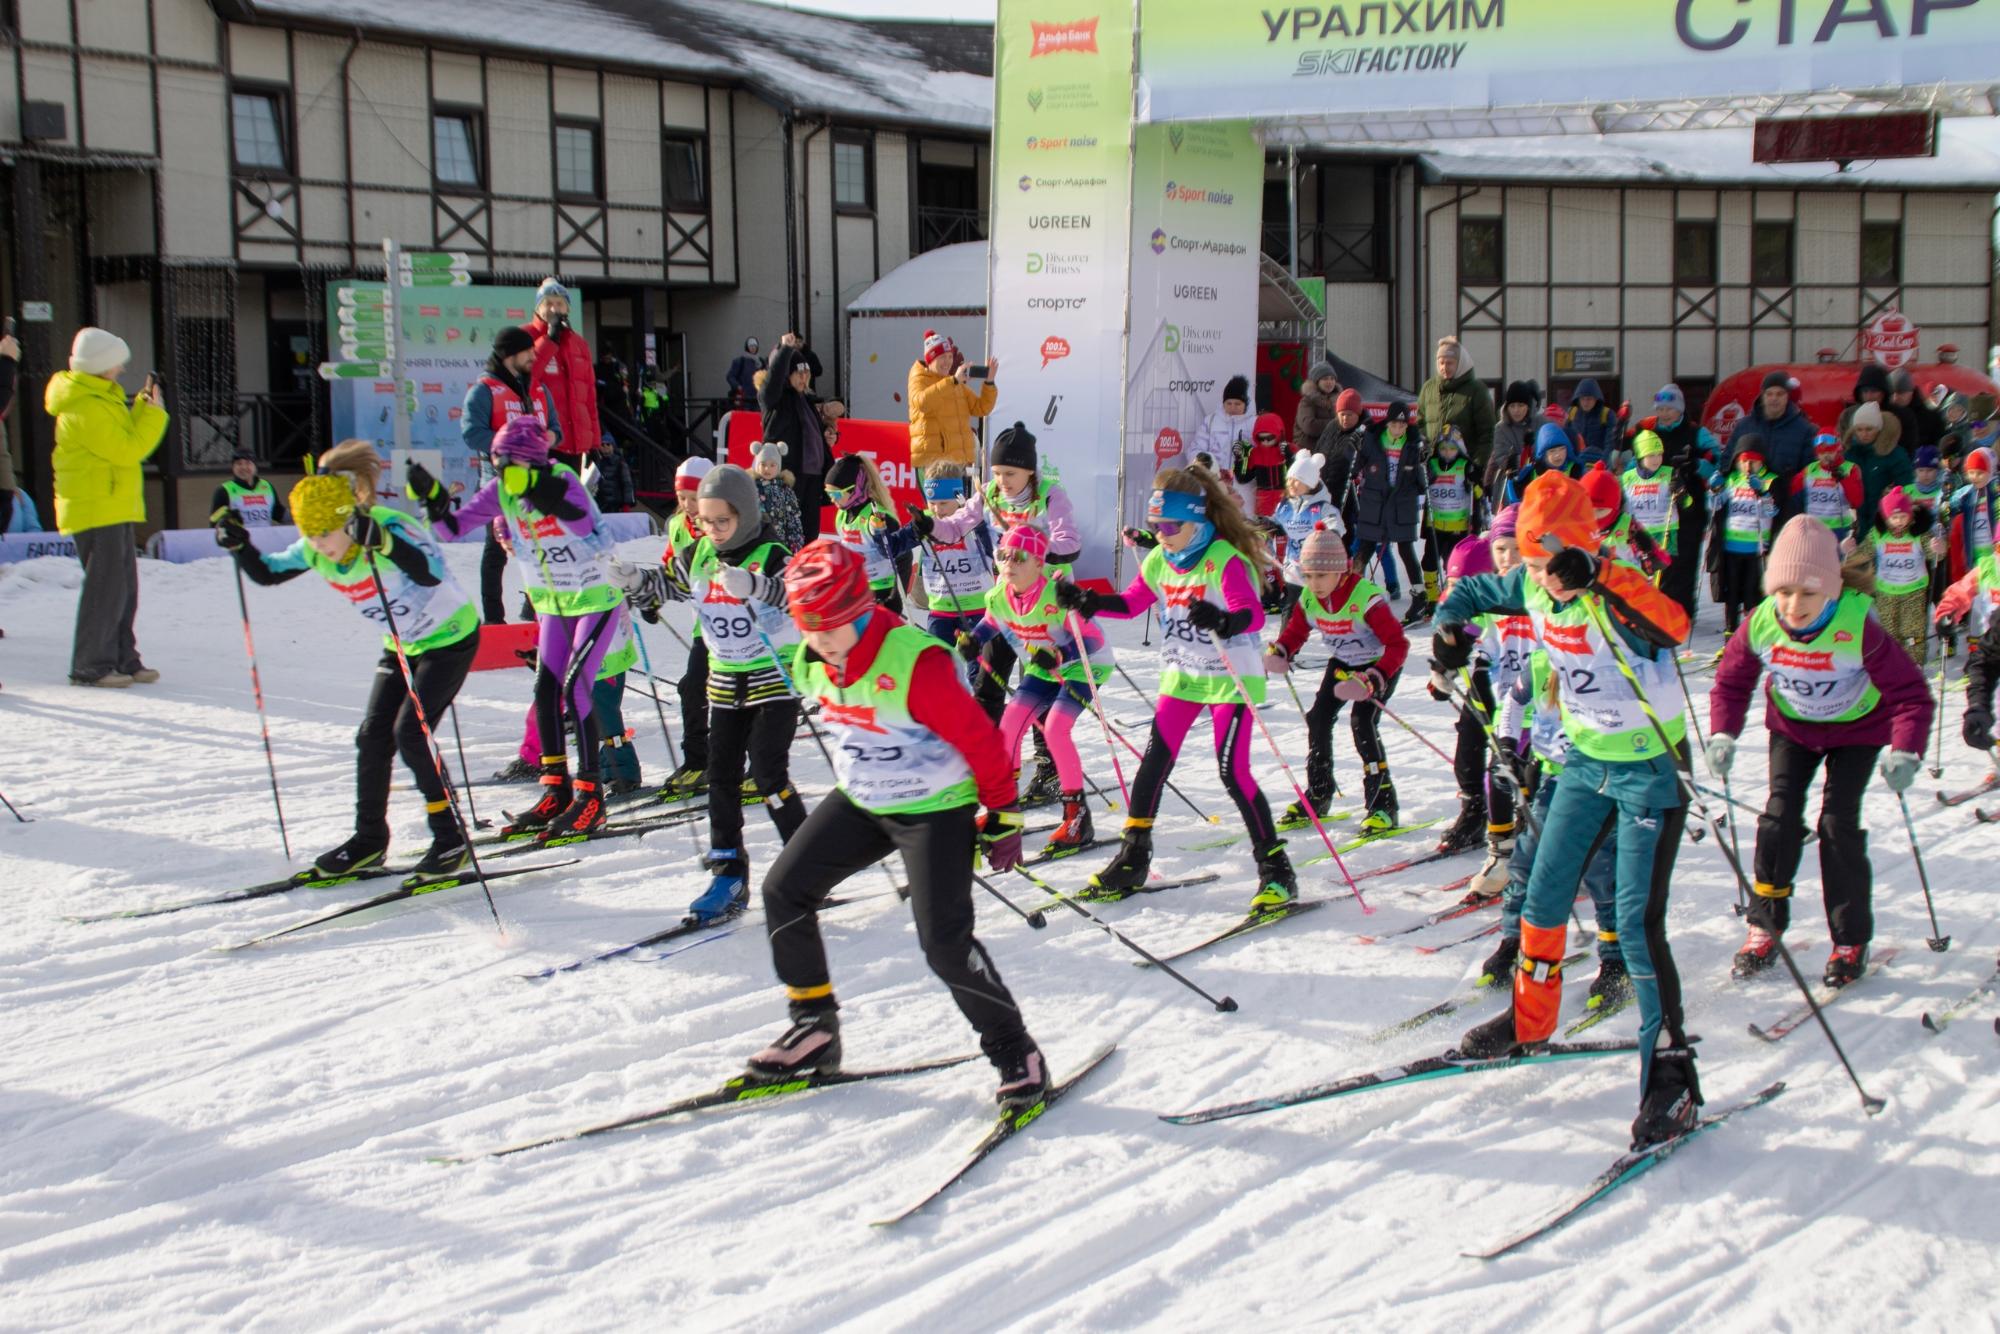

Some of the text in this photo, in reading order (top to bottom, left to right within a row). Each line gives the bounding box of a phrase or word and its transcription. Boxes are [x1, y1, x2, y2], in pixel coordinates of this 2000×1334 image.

[1260, 0, 1506, 42] УРАЛХИМ
[1068, 30, 1092, 42] Банк
[1292, 41, 1468, 77] SKIFACTORY
[1039, 135, 1098, 150] Sport noise
[1178, 185, 1234, 205] Sport noise
[1028, 215, 1092, 229] UGREEN
[1045, 252, 1090, 264] Discover
[1045, 263, 1081, 275] Fitness
[1173, 284, 1218, 301] UGREEN
[1182, 324, 1223, 341] Discover
[1182, 340, 1214, 354] Fitness
[1886, 558, 1915, 570] 448
